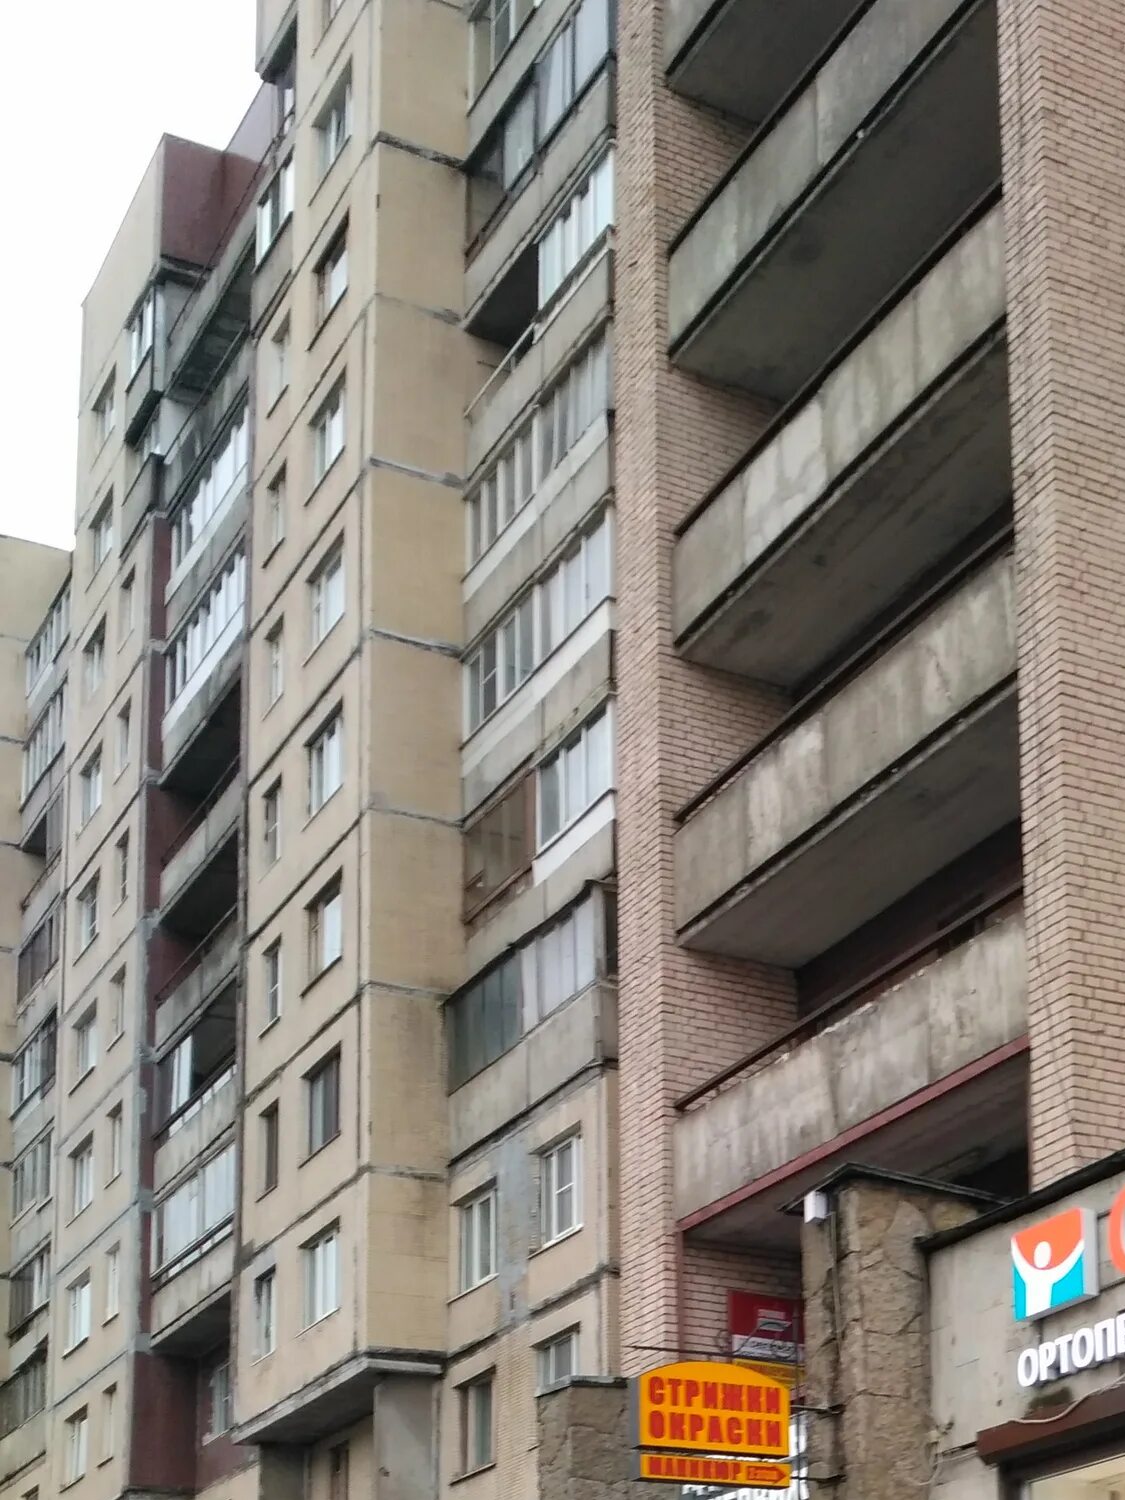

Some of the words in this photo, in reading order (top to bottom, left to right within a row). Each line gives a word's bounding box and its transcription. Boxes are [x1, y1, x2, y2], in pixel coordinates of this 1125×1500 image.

[649, 1376, 781, 1413] СТРИЖКИ
[649, 1409, 782, 1447] ОКРАСКИ
[649, 1456, 741, 1480] МАНИКЮР
